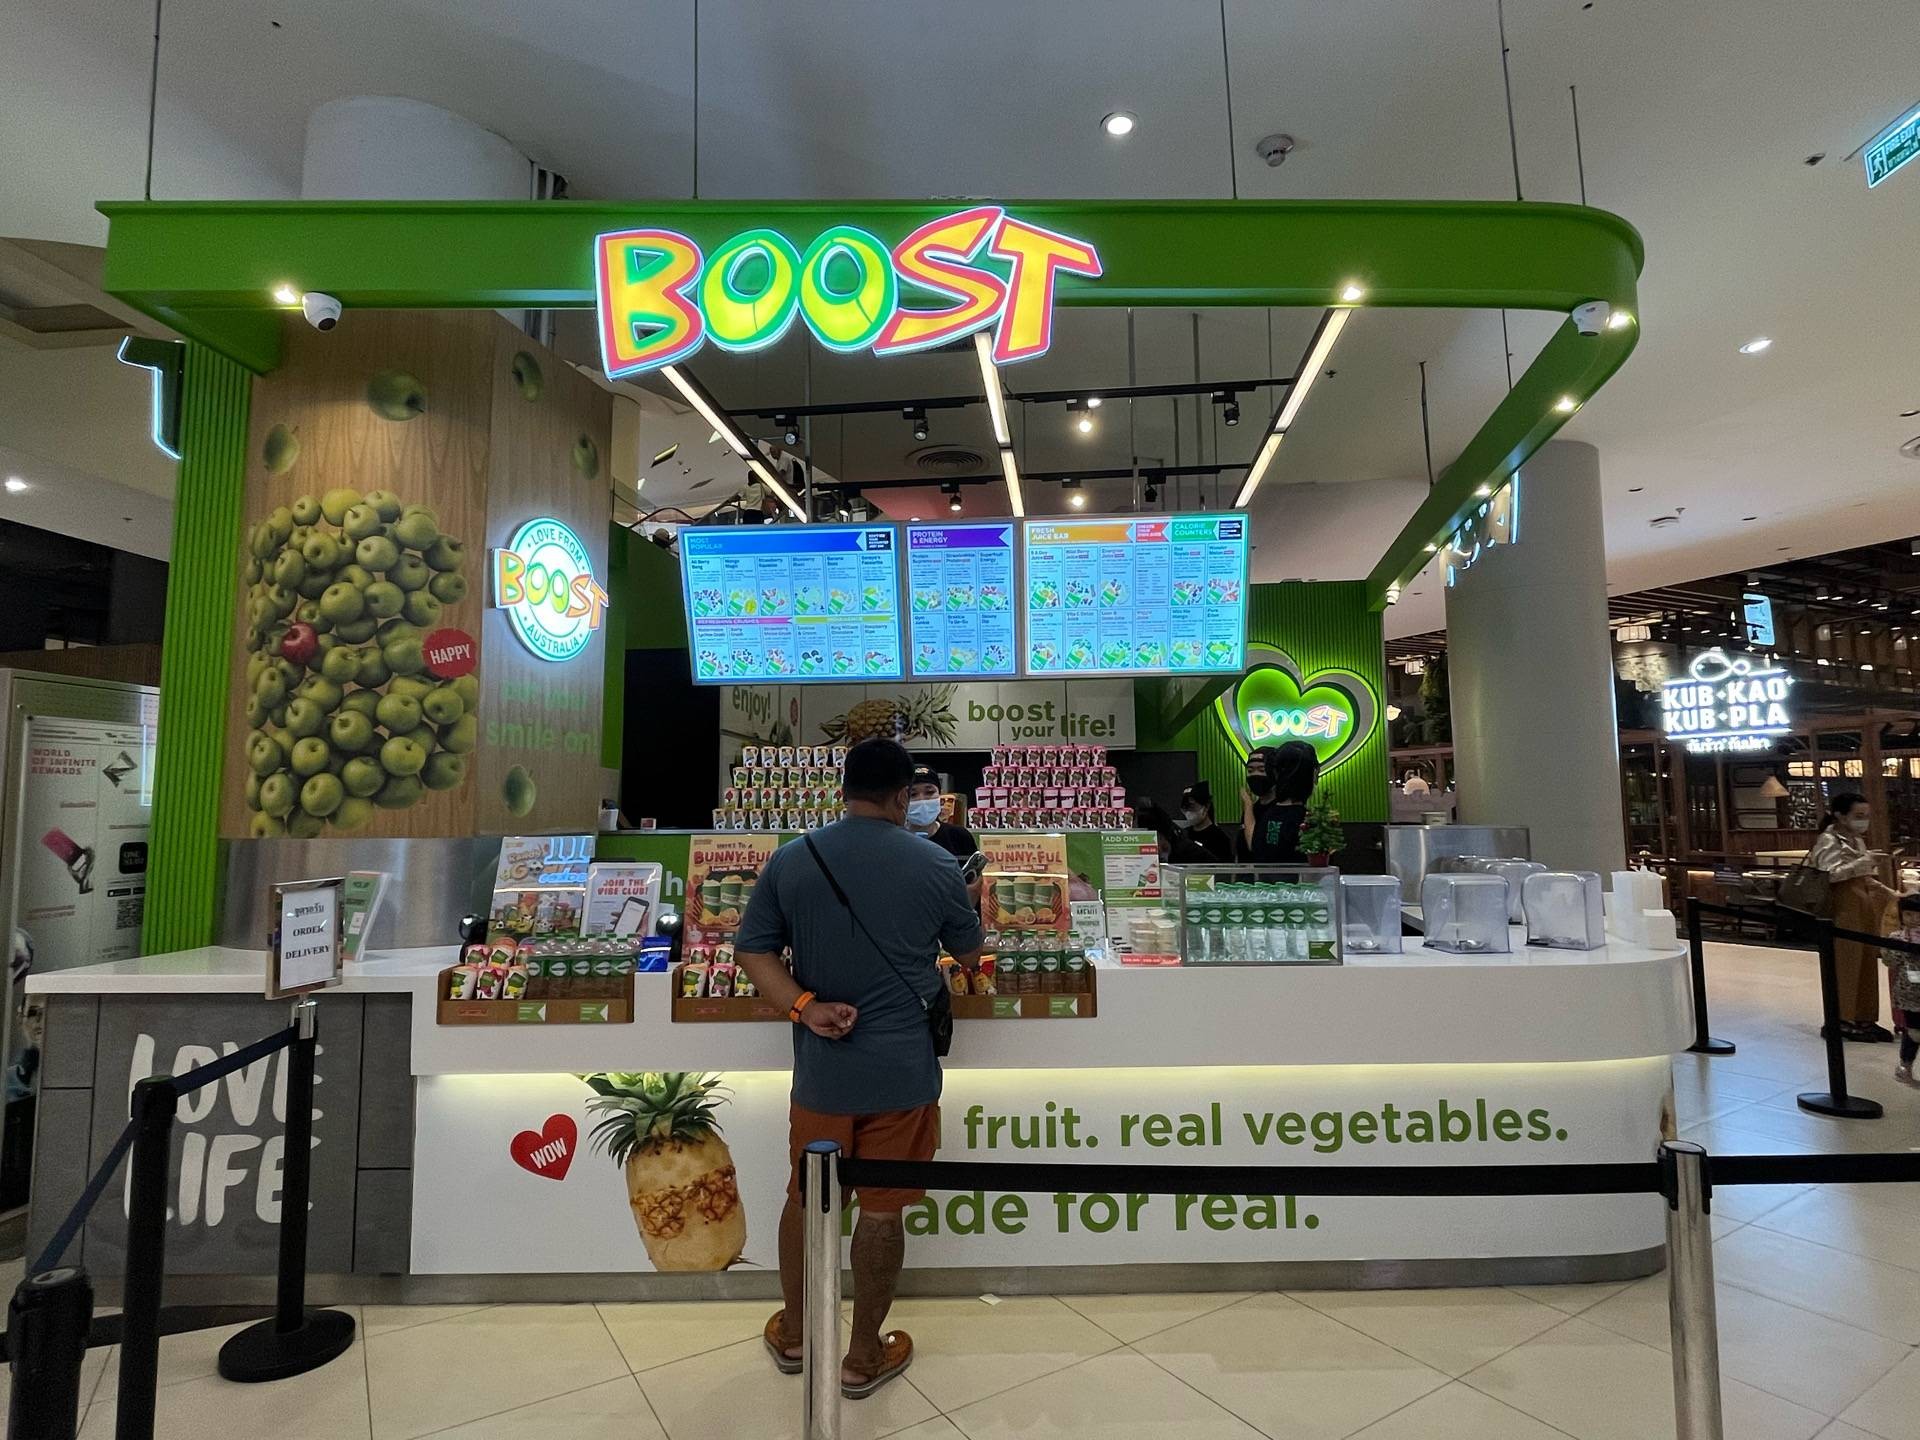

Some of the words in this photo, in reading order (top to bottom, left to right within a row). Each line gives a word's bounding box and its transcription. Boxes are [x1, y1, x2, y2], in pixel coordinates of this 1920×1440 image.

[594, 206, 1103, 378] BOOST
[531, 528, 556, 546] LOVE
[558, 531, 583, 564] FROM
[496, 548, 609, 630] BOOST
[526, 623, 580, 654] AUSTRALIA
[430, 644, 470, 665] HAPPY
[733, 685, 770, 725] enjoy!
[968, 700, 1055, 722] boost
[1011, 725, 1055, 741] your
[1060, 712, 1116, 737] life!
[1248, 705, 1348, 740] BOOST
[32, 757, 45, 765] OF
[50, 758, 96, 767] INFINITE
[33, 748, 71, 757] WORLD
[31, 766, 82, 775] REWARDS
[1105, 835, 1120, 843] ADD
[985, 850, 1063, 864] BUNNY-FUL
[598, 887, 618, 895] VIBE
[621, 887, 648, 895] CLUB!
[603, 879, 625, 887] JOIN
[293, 925, 324, 937] ORDER
[285, 945, 330, 960] DELIVERY
[963, 1101, 1099, 1149] fruit.
[1121, 1102, 1222, 1147] real
[1243, 1099, 1568, 1153] vegetables.
[530, 1137, 568, 1169] WOW
[124, 1132, 322, 1227] IFE
[840, 1191, 1029, 1237] ade
[1054, 1190, 1150, 1234] for
[1175, 1193, 1320, 1231] real.
